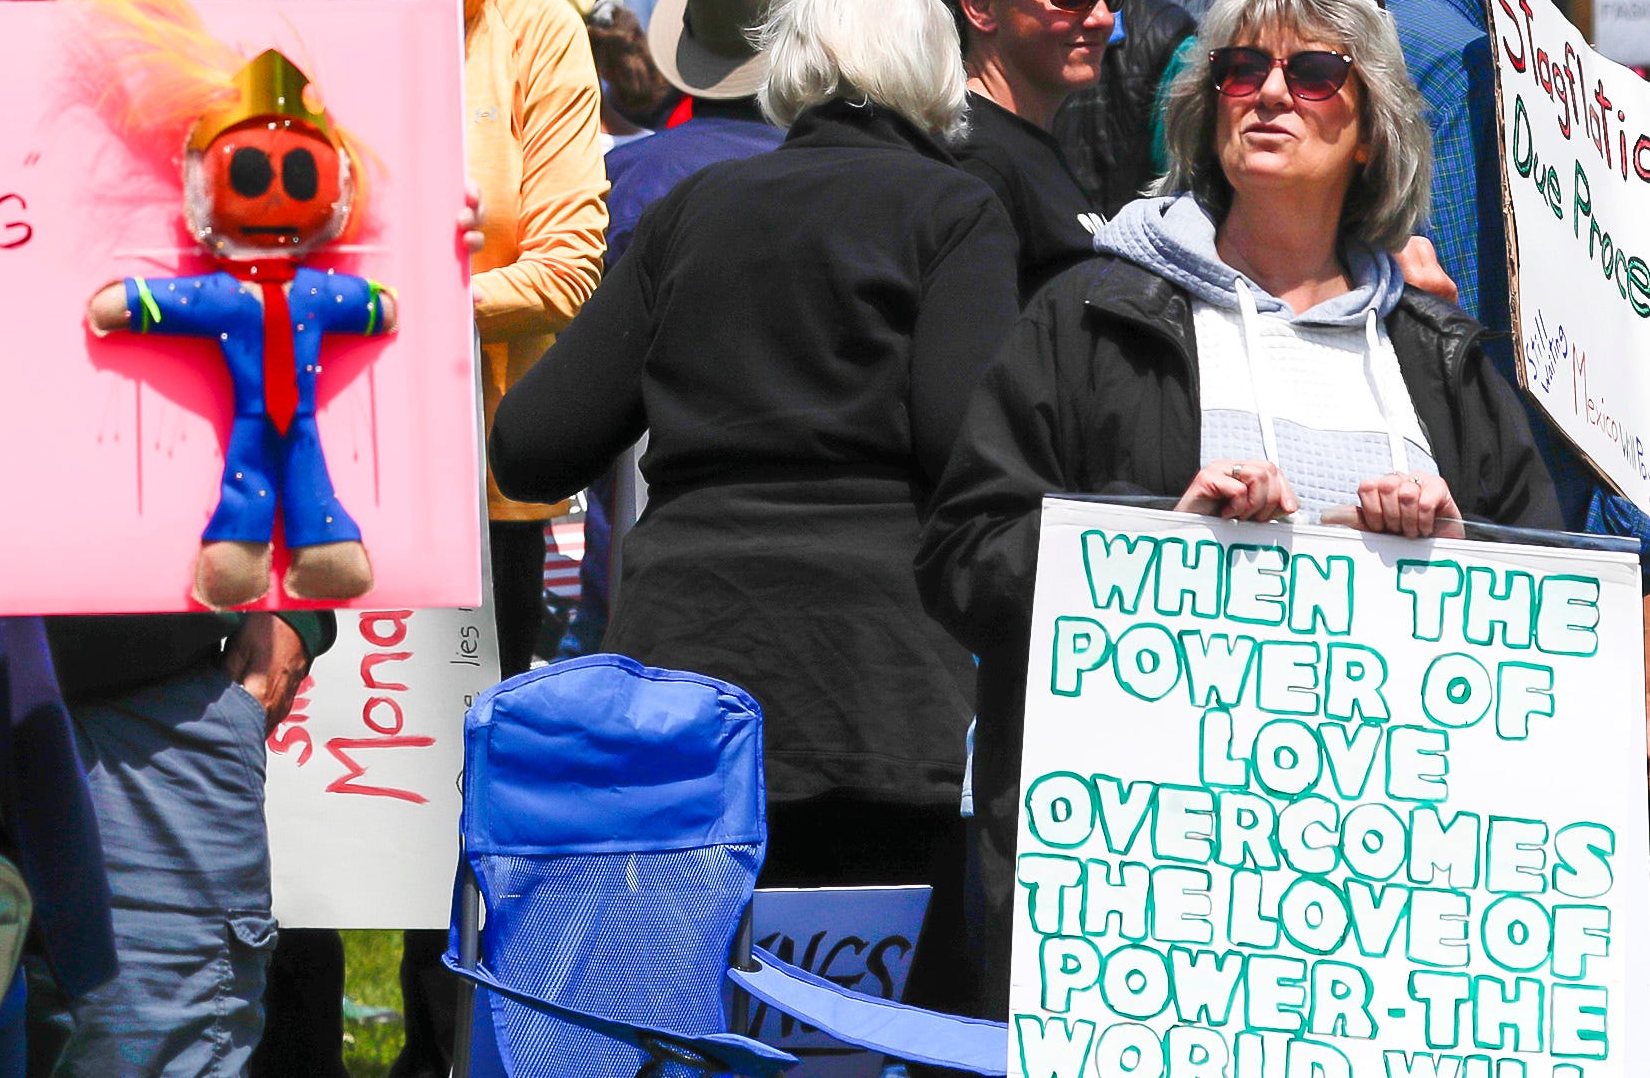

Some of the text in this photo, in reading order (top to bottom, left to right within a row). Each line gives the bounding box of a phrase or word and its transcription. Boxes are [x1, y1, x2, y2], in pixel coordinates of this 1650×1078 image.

[1513, 94, 1563, 220] Due
[1525, 308, 1549, 381] Still
[1572, 342, 1619, 443] Mexico
[1635, 435, 1650, 481] Pa
[449, 625, 481, 667] lies
[1080, 529, 1601, 658] WHEN THE
[1050, 616, 1556, 741] POWER OF
[1199, 705, 1451, 803] LOVE
[1025, 770, 1616, 900] OVERCOMES
[1016, 853, 1611, 982] THE LOVE OF
